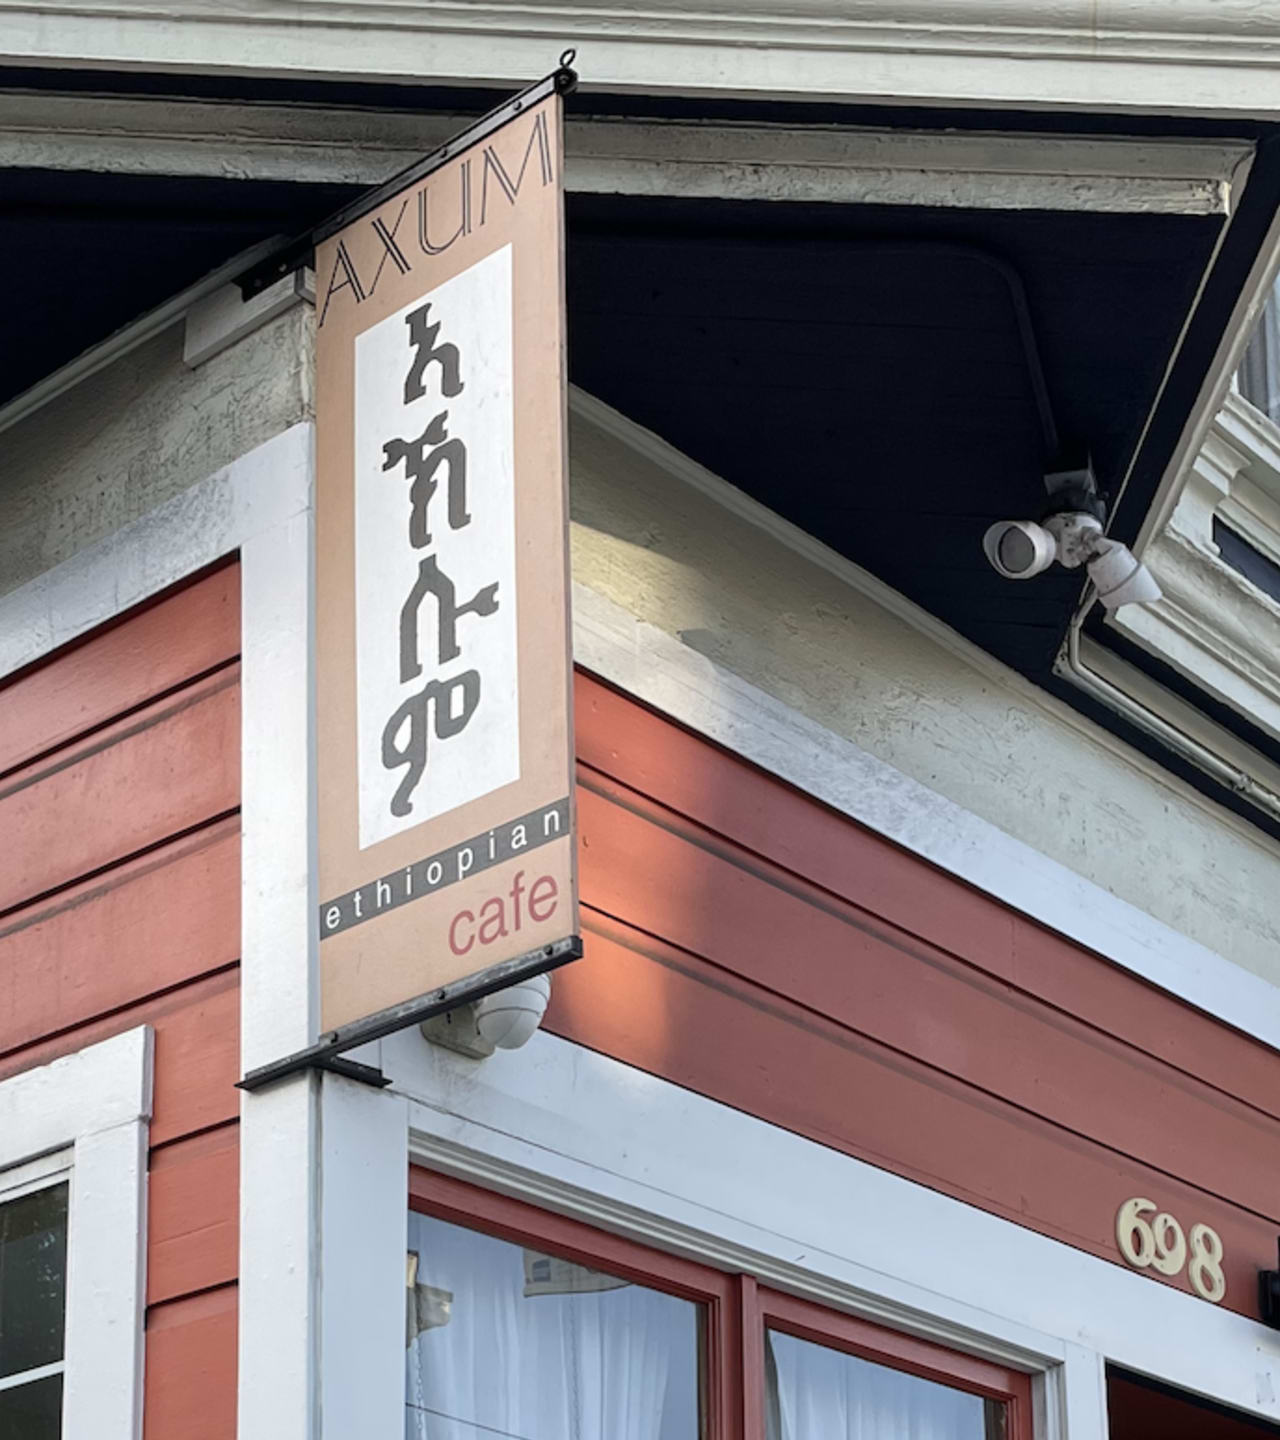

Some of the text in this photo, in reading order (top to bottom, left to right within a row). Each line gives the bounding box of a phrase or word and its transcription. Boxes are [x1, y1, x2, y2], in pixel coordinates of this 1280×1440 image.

[319, 110, 554, 328] AXUM
[325, 809, 561, 930] ethiopian
[448, 870, 559, 957] cafe
[1116, 1198, 1226, 1303] 698
